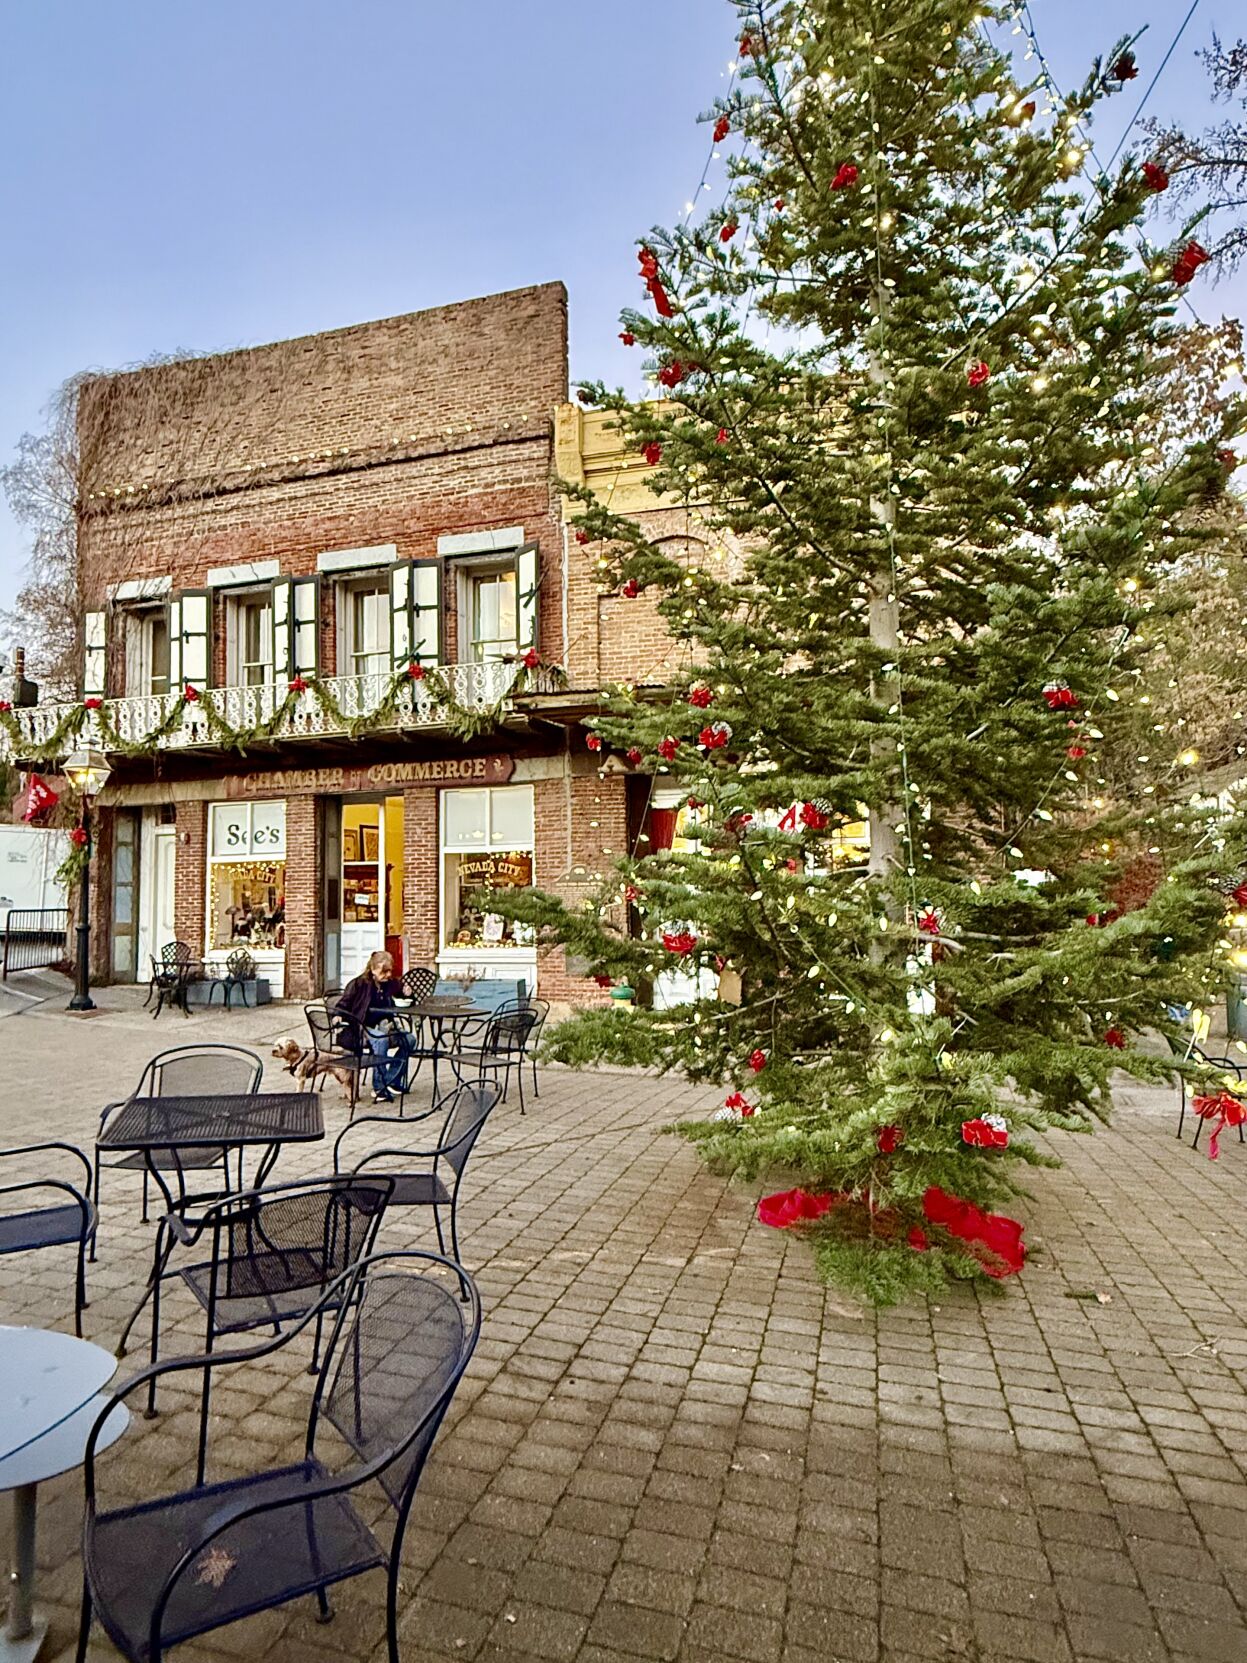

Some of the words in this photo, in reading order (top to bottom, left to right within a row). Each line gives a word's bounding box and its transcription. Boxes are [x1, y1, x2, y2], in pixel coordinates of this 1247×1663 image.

[243, 767, 344, 791] CHAMBER
[367, 758, 486, 784] COMMERCE
[227, 824, 280, 846] See's
[257, 869, 276, 884] CITY
[457, 860, 496, 876] NEVADA
[497, 861, 521, 876] CITY
